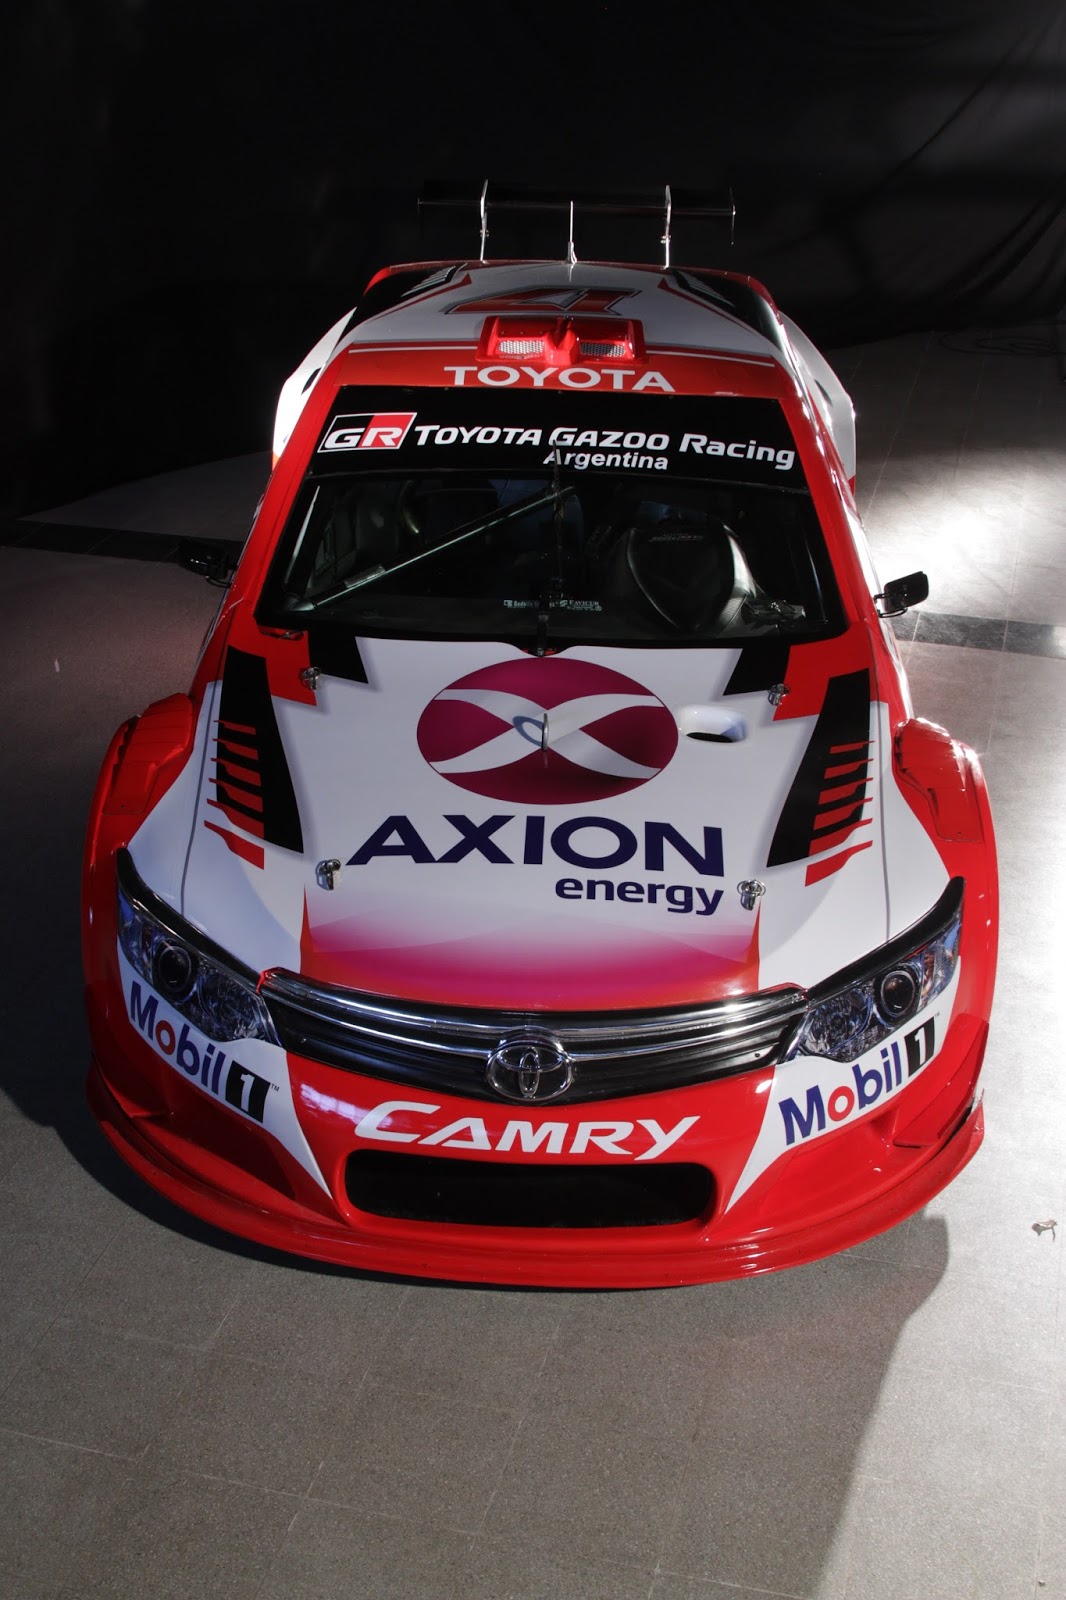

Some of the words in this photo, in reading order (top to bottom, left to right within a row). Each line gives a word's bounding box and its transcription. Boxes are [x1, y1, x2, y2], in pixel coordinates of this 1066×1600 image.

[439, 284, 642, 316] 4
[444, 366, 675, 393] TOYOTA
[325, 427, 403, 449] GR
[414, 425, 543, 446] TOYOTA
[548, 427, 670, 451] GAZOO
[679, 433, 795, 471] Racing
[543, 449, 669, 470] Argentina
[346, 815, 725, 878] AXION
[556, 879, 724, 916] energy
[130, 980, 226, 1095] Mobil
[779, 1041, 902, 1146] Mobil
[355, 1100, 701, 1161] CAMRY
